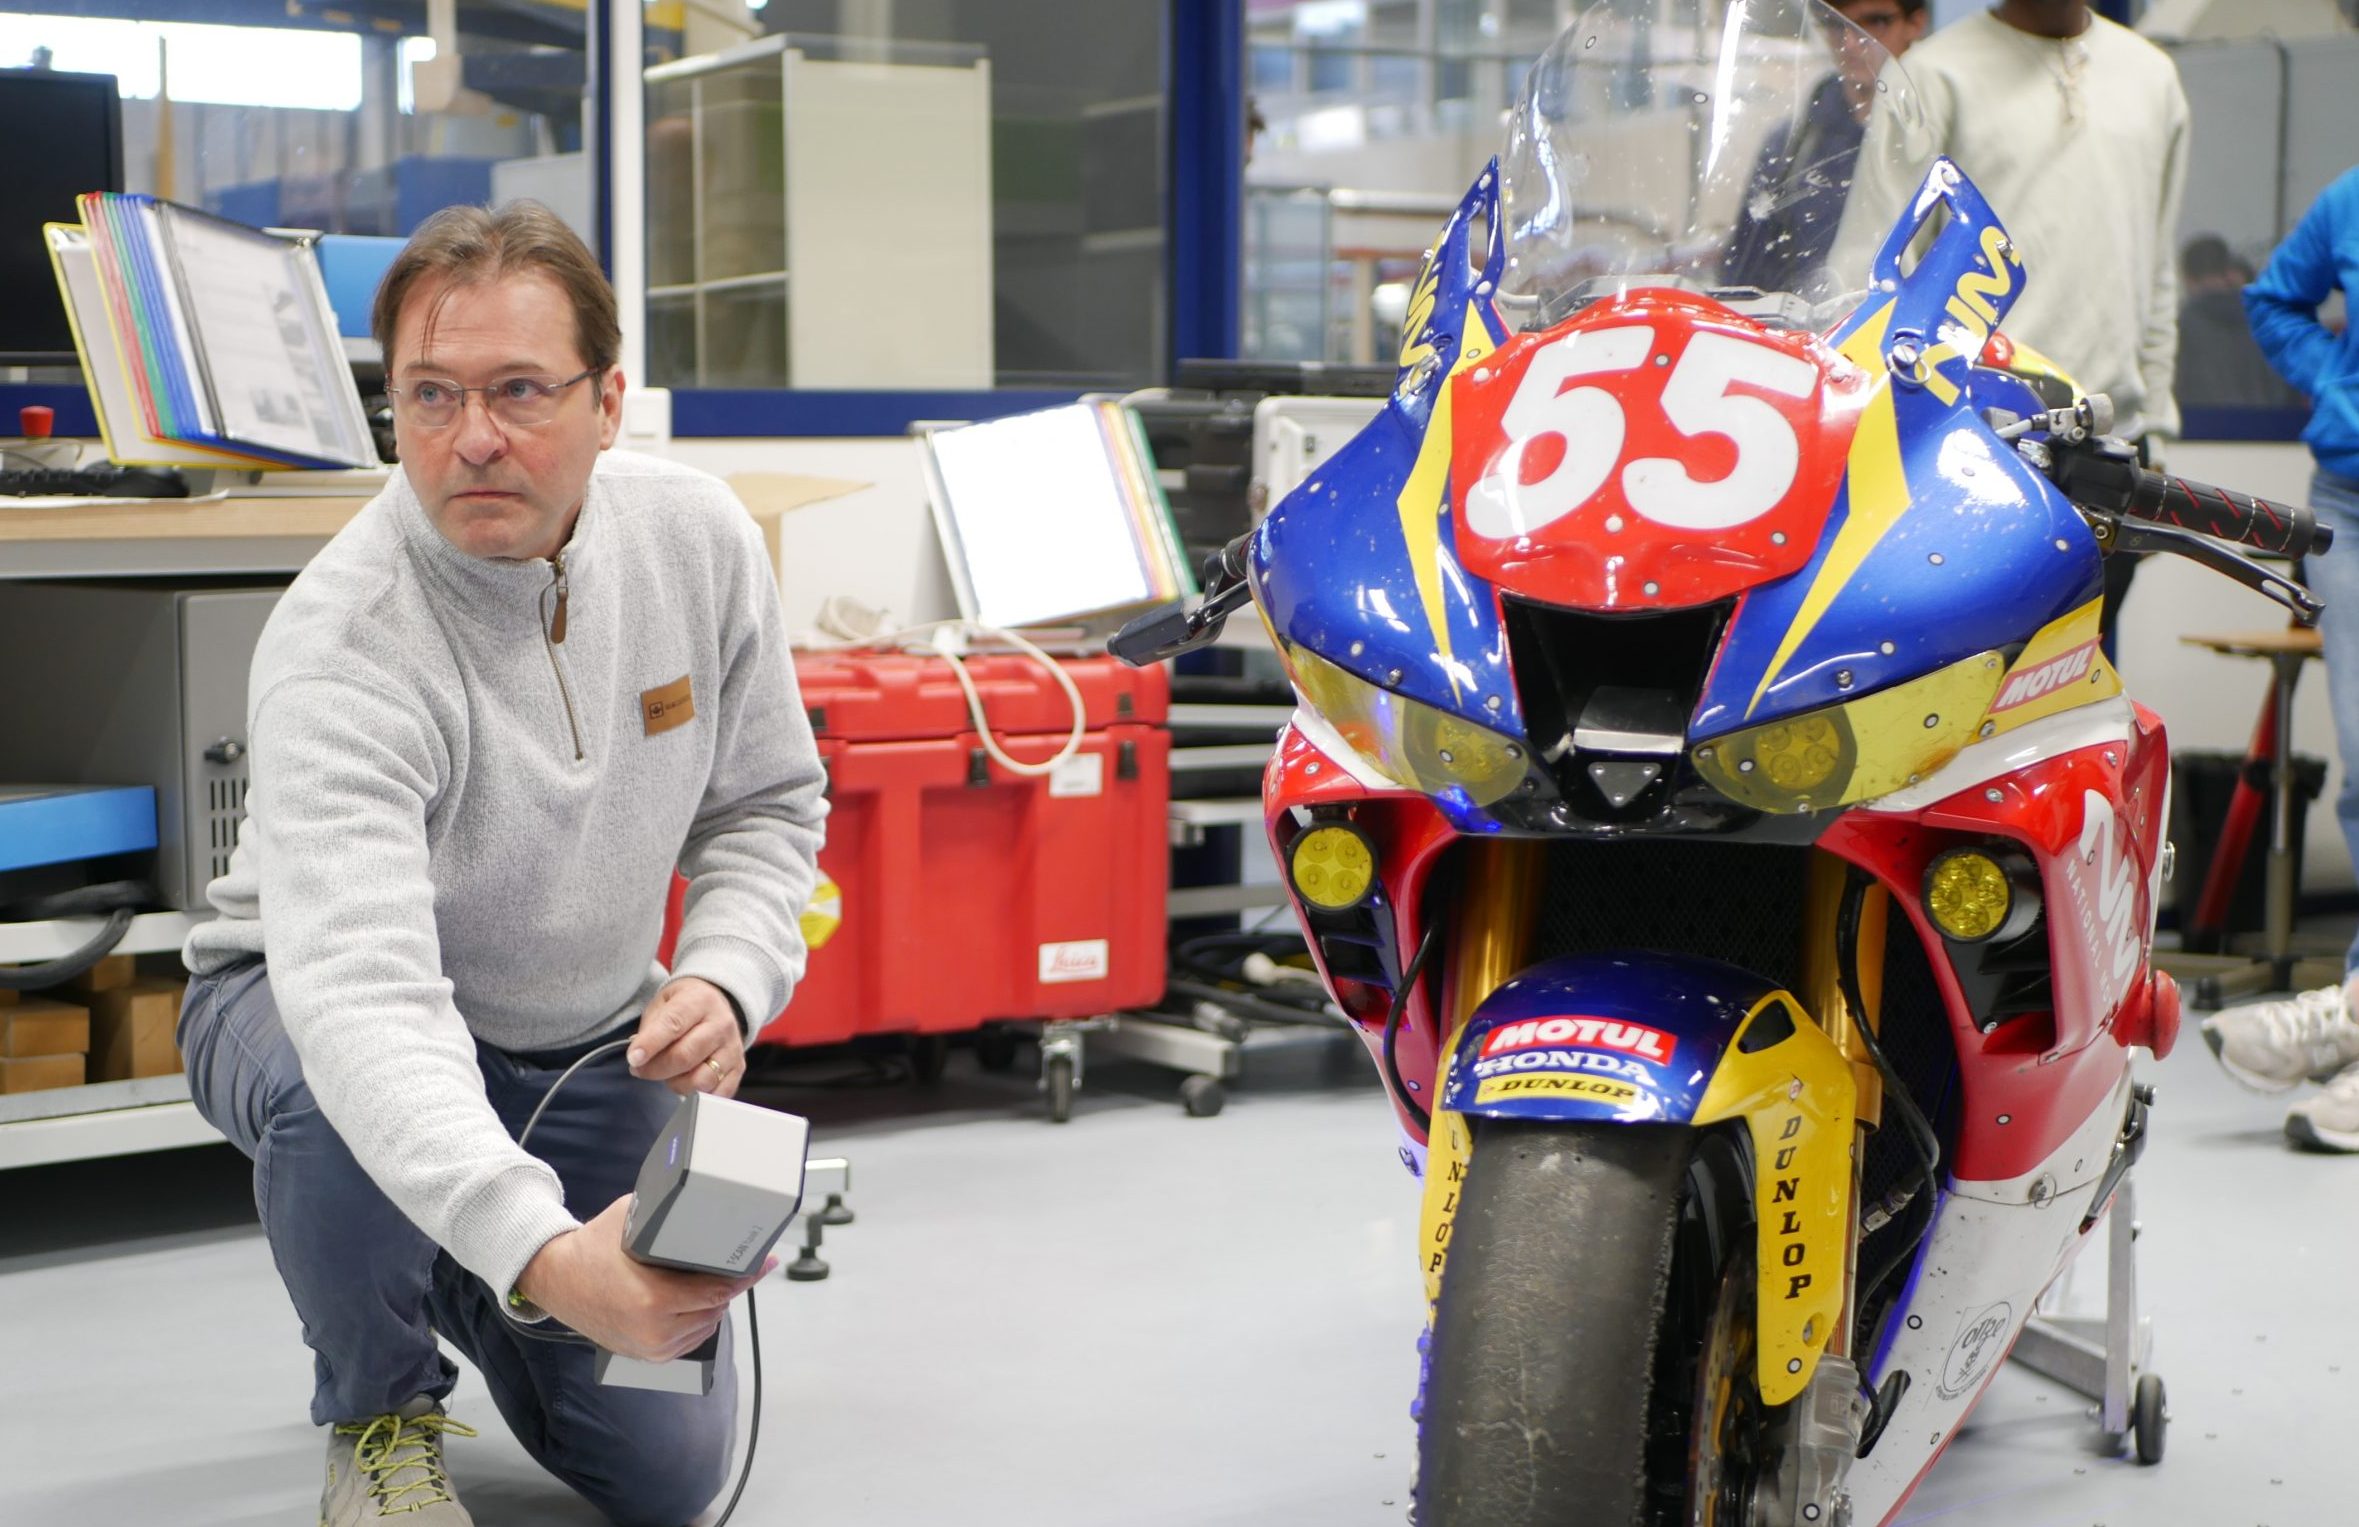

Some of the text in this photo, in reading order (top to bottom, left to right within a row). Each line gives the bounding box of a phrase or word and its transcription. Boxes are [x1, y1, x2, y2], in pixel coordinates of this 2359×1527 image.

[1995, 645, 2093, 709] MOTUL
[2066, 859, 2102, 970] NATIONAL
[1488, 1019, 1665, 1057] MOTUL
[1476, 1051, 1658, 1087] HONDA
[1499, 1078, 1636, 1099] DUNLOP
[1772, 1115, 1812, 1299] DUNLOP
